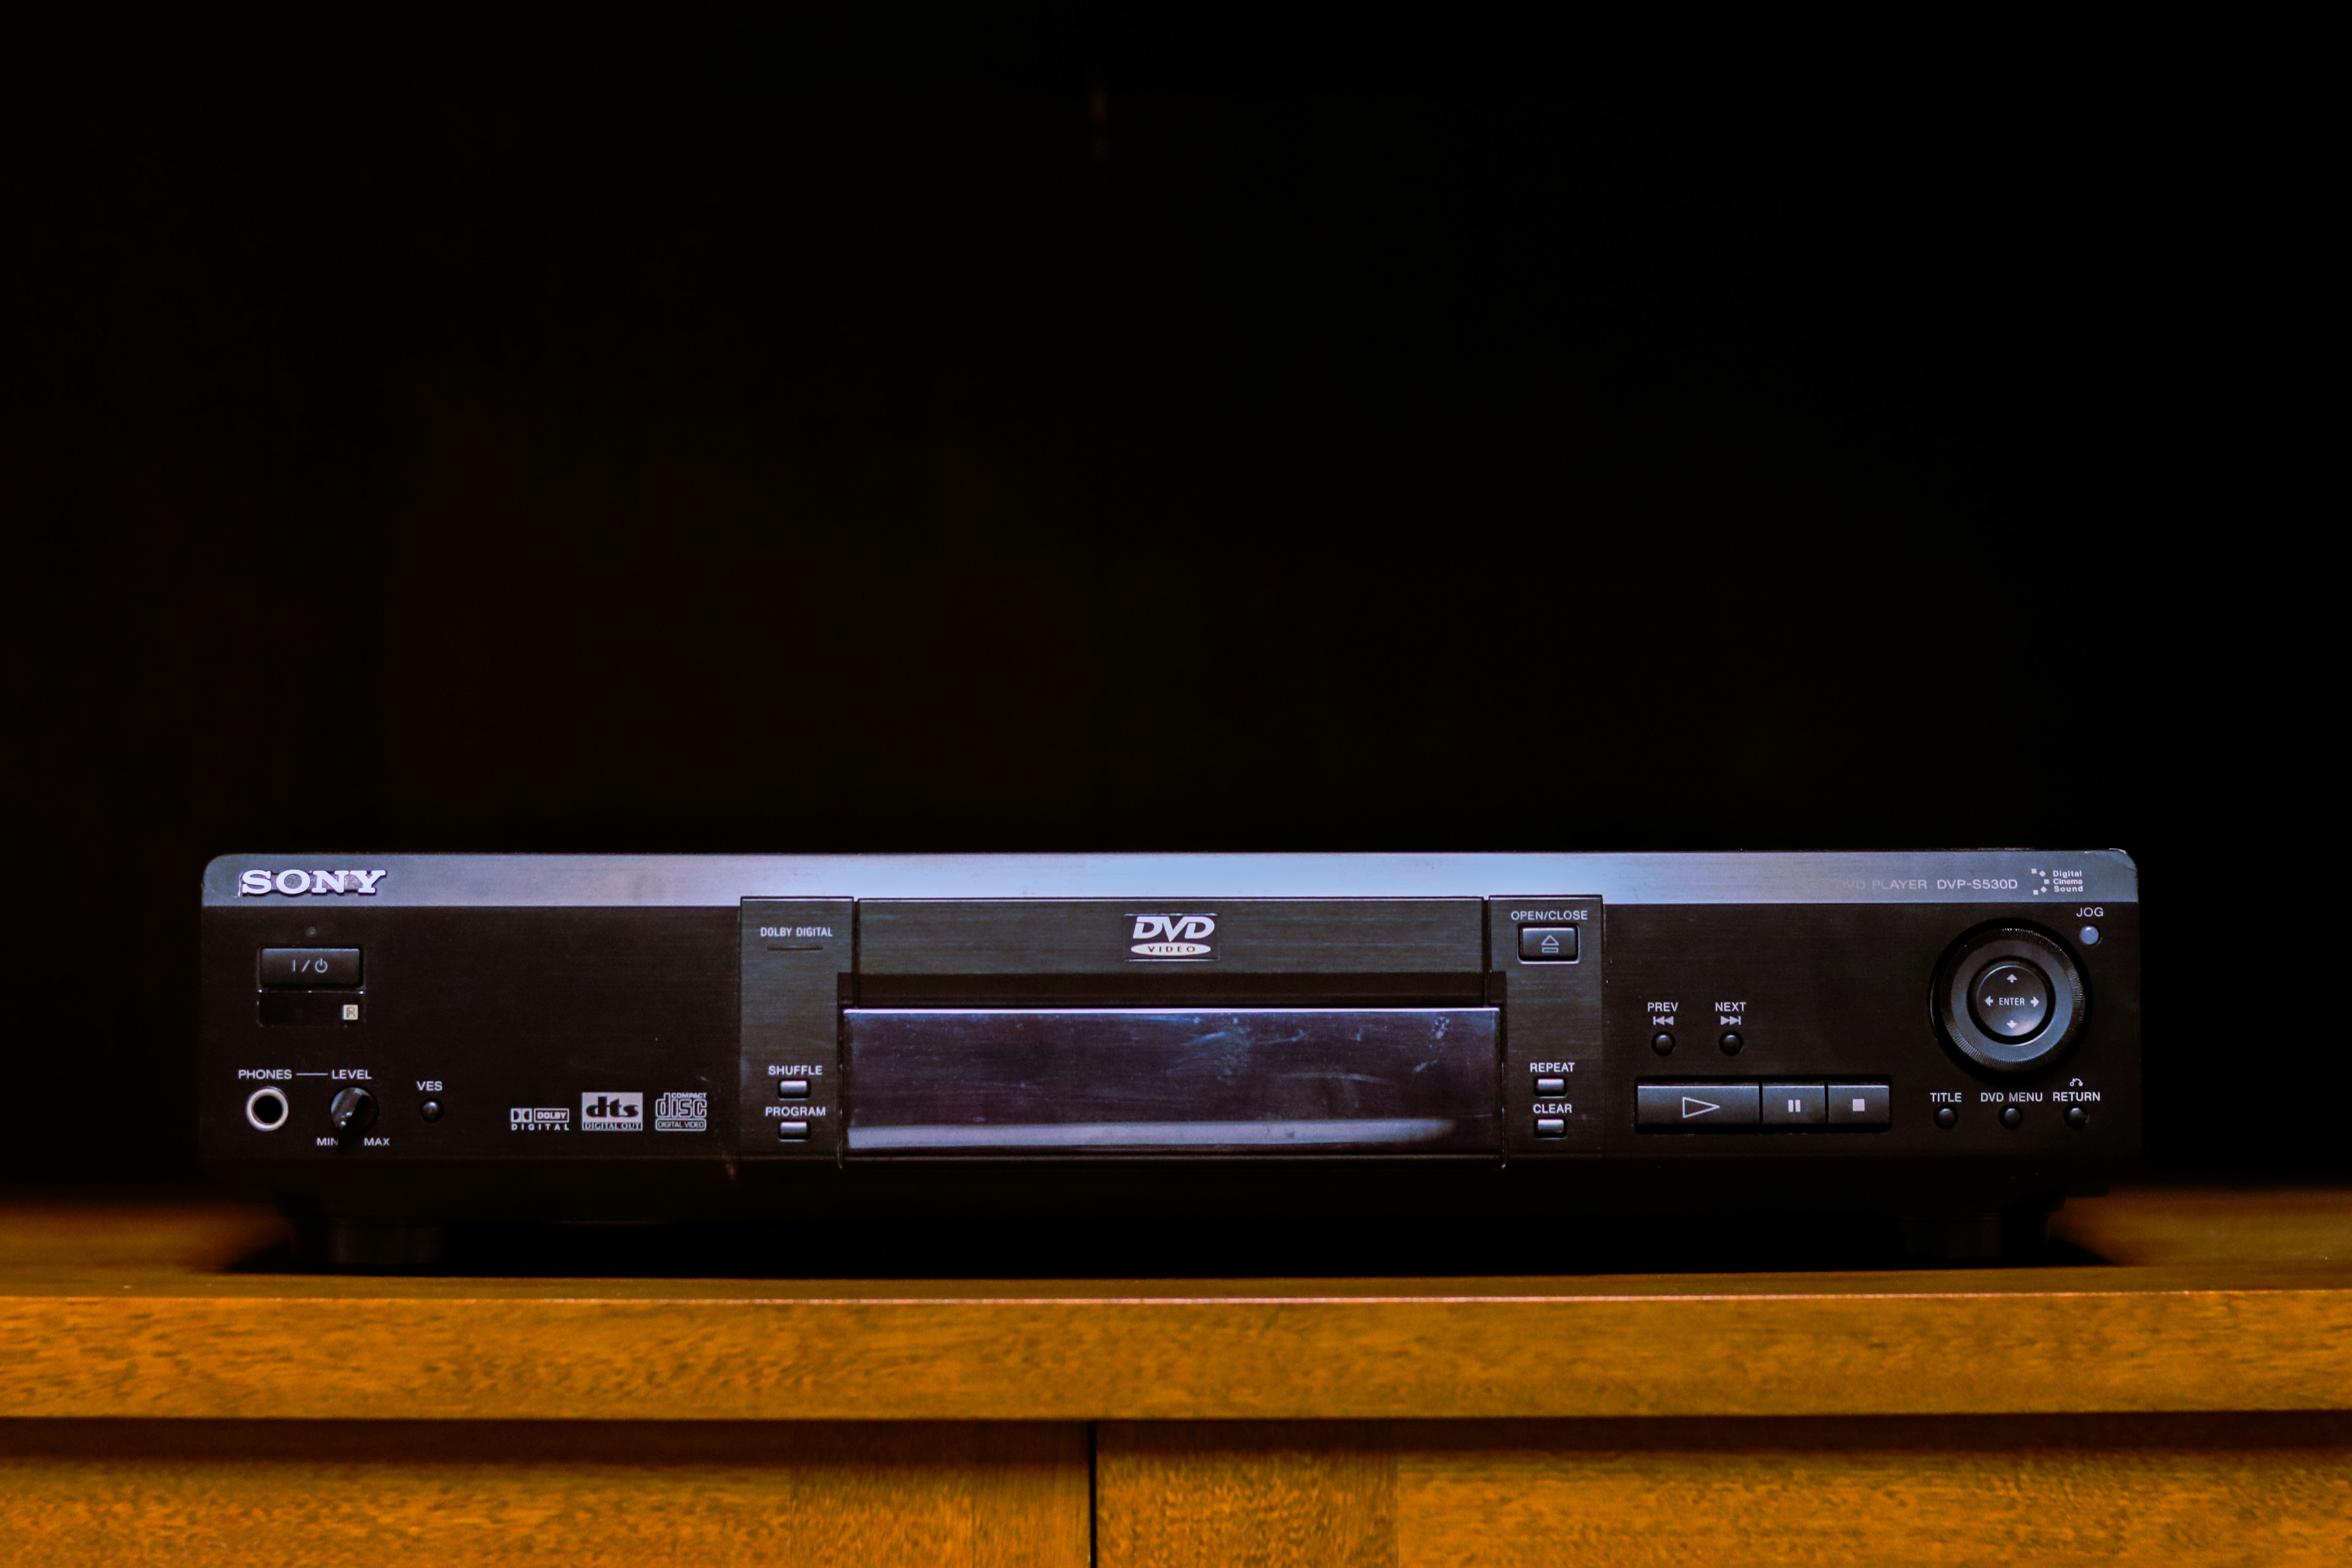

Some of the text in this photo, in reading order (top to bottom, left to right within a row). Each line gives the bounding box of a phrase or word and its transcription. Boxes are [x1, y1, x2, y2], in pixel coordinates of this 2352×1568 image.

[2052, 870, 2082, 878] Digital
[242, 870, 386, 894] SONY
[1872, 879, 1928, 890] PLAYER
[1937, 879, 2018, 890] DVP-S530D
[1510, 910, 1588, 920] OPEN/CLOSE
[2076, 906, 2104, 917] JOG
[760, 926, 834, 937] DOLBY DIGITAL
[1132, 916, 1215, 942] DVD
[1647, 1002, 1678, 1012] PREV
[1715, 1002, 1746, 1012] NEXT
[1998, 997, 2025, 1006] ENTER
[768, 1065, 823, 1076] SHUFFLE
[1529, 1062, 1575, 1073] REPEAT
[238, 1069, 292, 1080] PHONES
[331, 1069, 372, 1080] LEVEL
[416, 1080, 443, 1092] VES
[1929, 1092, 1962, 1102] TITLE
[1981, 1092, 2043, 1102] DVD MENU
[2052, 1092, 2101, 1102] RETURN
[586, 1096, 639, 1118] dts
[765, 1106, 826, 1117] PROGRAM
[1533, 1103, 1573, 1114] CLEAR
[537, 1111, 567, 1120] DOLBY
[510, 1123, 570, 1132] DIGITAL
[317, 1137, 338, 1147] MIN
[363, 1137, 390, 1147] MAX
